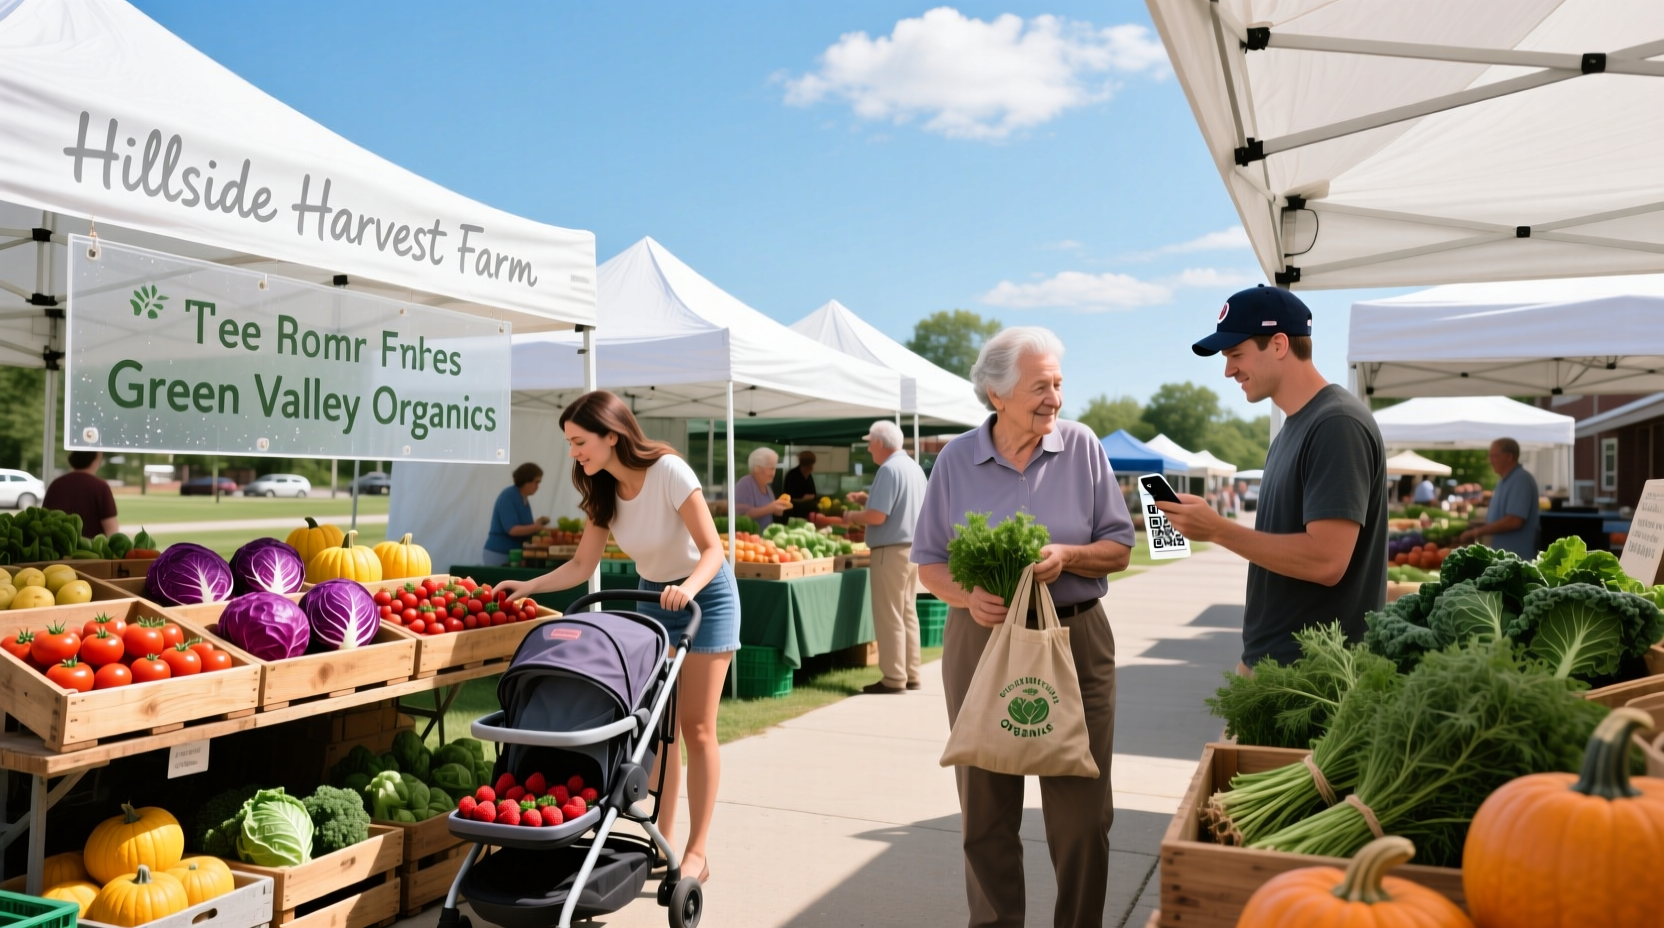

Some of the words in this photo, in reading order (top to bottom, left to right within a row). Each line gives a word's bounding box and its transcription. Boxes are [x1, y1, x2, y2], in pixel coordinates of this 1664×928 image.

[63, 111, 278, 223] Hillside
[291, 174, 448, 266] Harvest
[457, 223, 538, 288] Farm
[185, 299, 261, 351] Tee
[277, 314, 367, 363] Romr
[107, 359, 240, 415] Green
[254, 373, 361, 435] Valley
[372, 385, 497, 441] Organics
